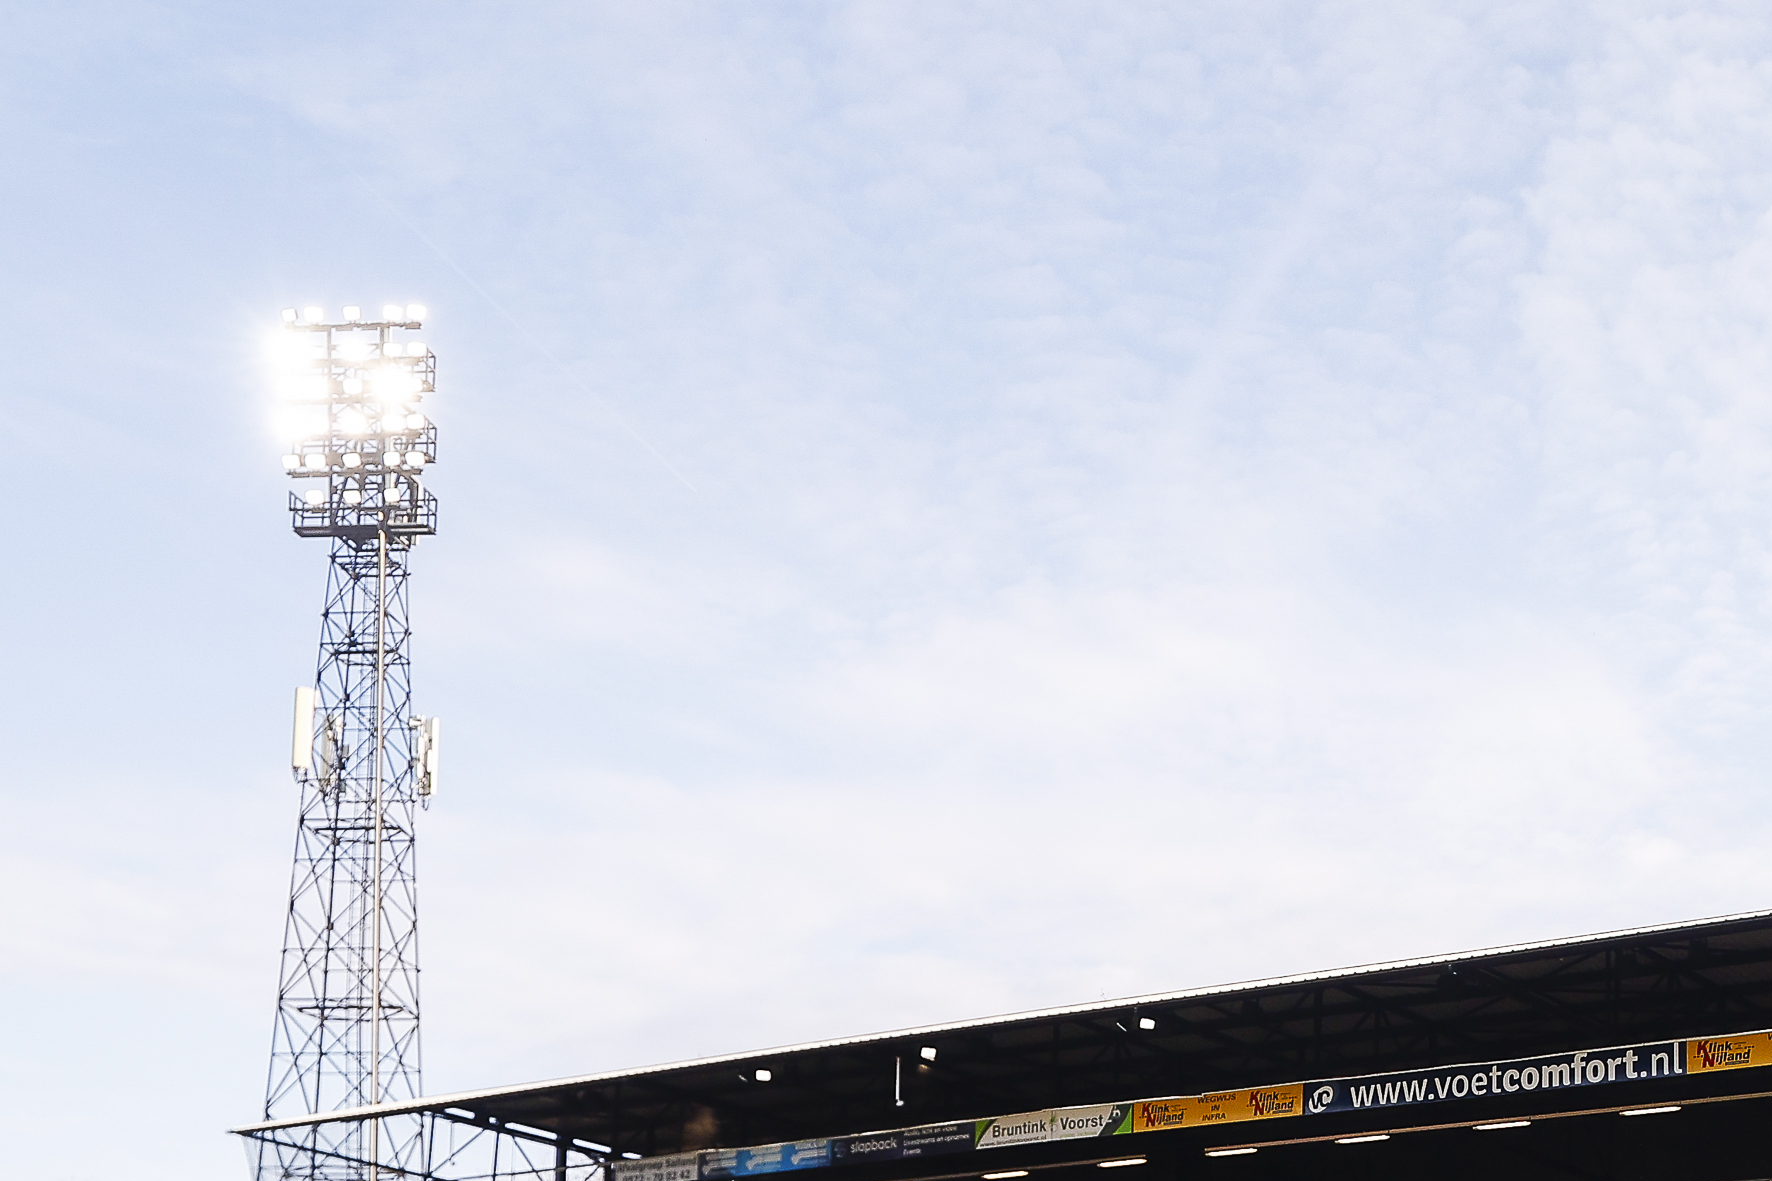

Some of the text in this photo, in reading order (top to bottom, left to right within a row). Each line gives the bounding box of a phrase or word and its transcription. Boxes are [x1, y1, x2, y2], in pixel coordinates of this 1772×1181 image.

[1697, 1041, 1733, 1056] Klink
[1350, 1042, 1682, 1108] www.voetcomfort.nl
[1250, 1091, 1279, 1105] Klink
[1142, 1103, 1170, 1118] Klink
[1211, 1104, 1220, 1112] IN
[1202, 1112, 1226, 1121] INFRA
[992, 1120, 1047, 1138] Bruntink
[1060, 1114, 1103, 1131] Voorst
[850, 1138, 898, 1154] slapback
